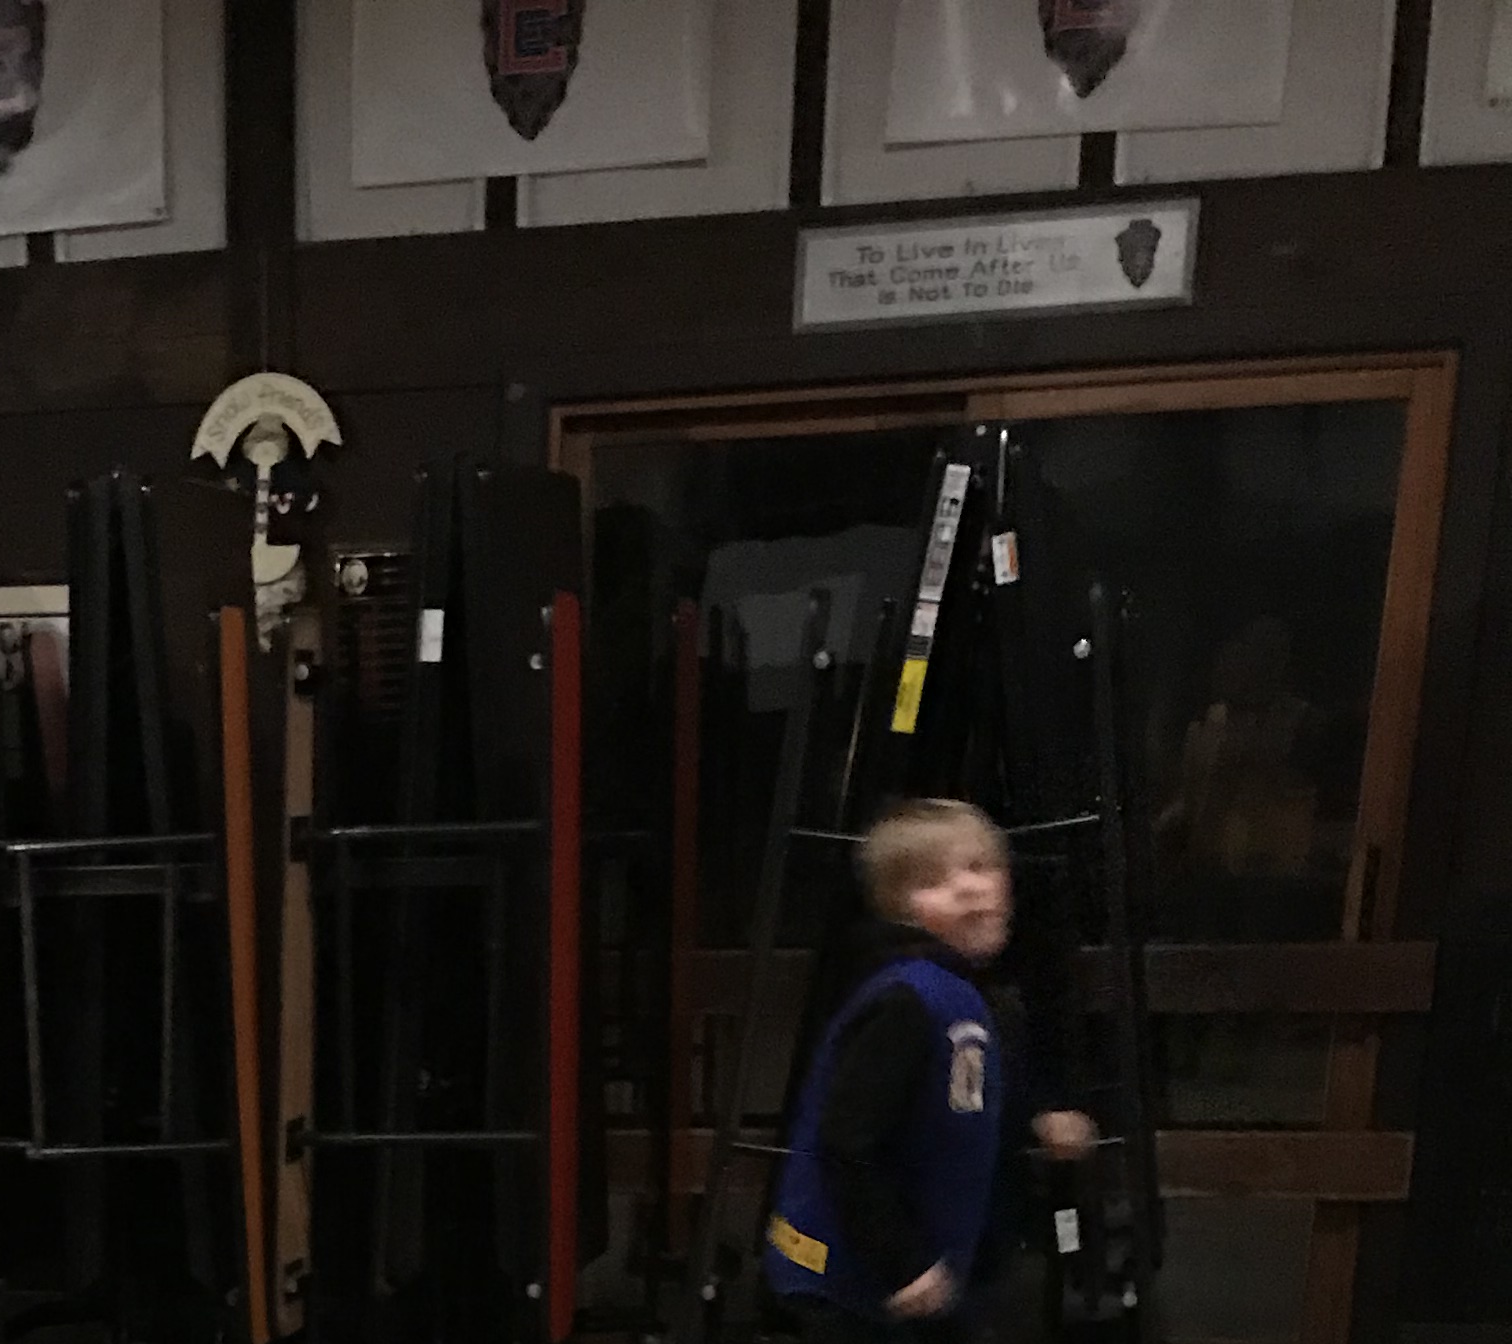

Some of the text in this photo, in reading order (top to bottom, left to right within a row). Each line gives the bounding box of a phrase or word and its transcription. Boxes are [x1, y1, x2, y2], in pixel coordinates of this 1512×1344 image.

[854, 244, 885, 265] To
[896, 243, 955, 263] Live
[964, 237, 988, 256] In
[828, 269, 878, 289] That
[890, 265, 960, 284] Come
[969, 258, 1035, 277] After
[908, 285, 952, 303] Not
[963, 281, 989, 298] To
[997, 279, 1035, 296] Die
